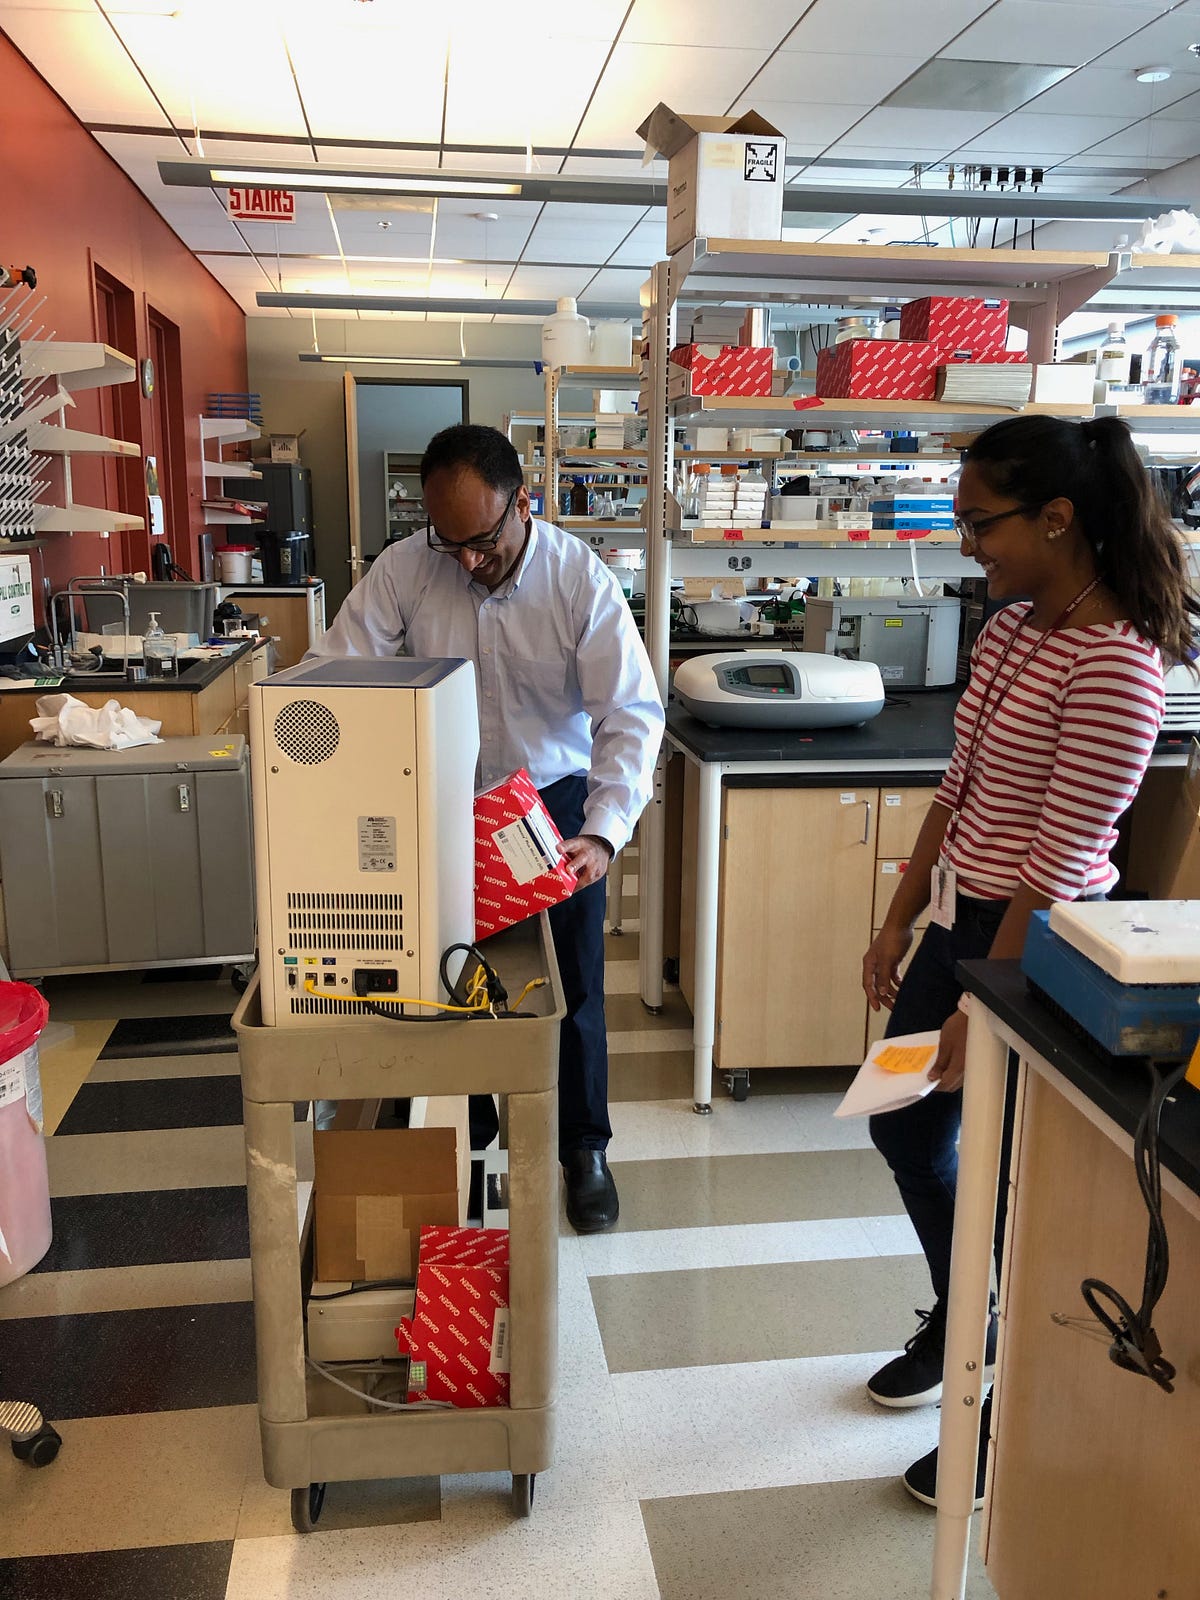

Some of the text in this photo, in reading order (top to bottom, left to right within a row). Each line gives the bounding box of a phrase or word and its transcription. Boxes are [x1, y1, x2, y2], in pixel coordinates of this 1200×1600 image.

[475, 814, 499, 826] QIAGEN
[474, 837, 492, 848] AGEN
[484, 875, 507, 888] QIAGEN
[478, 896, 501, 909] QIAGEN
[505, 894, 529, 906] QIAGEN
[533, 892, 557, 904] QIAGEN
[416, 1288, 431, 1305] AGEN
[460, 1277, 480, 1299] QIAGEN
[439, 1294, 460, 1316] QIAGEN
[418, 1312, 439, 1333] QIAGEN
[469, 1307, 490, 1329] QIAGEN
[448, 1324, 470, 1346] QIAGEN
[428, 1342, 448, 1364] QIAGEN
[457, 1353, 478, 1375] QIAGEN
[436, 1370, 458, 1393] QIAGEN
[466, 1383, 487, 1405] QIAGEN
